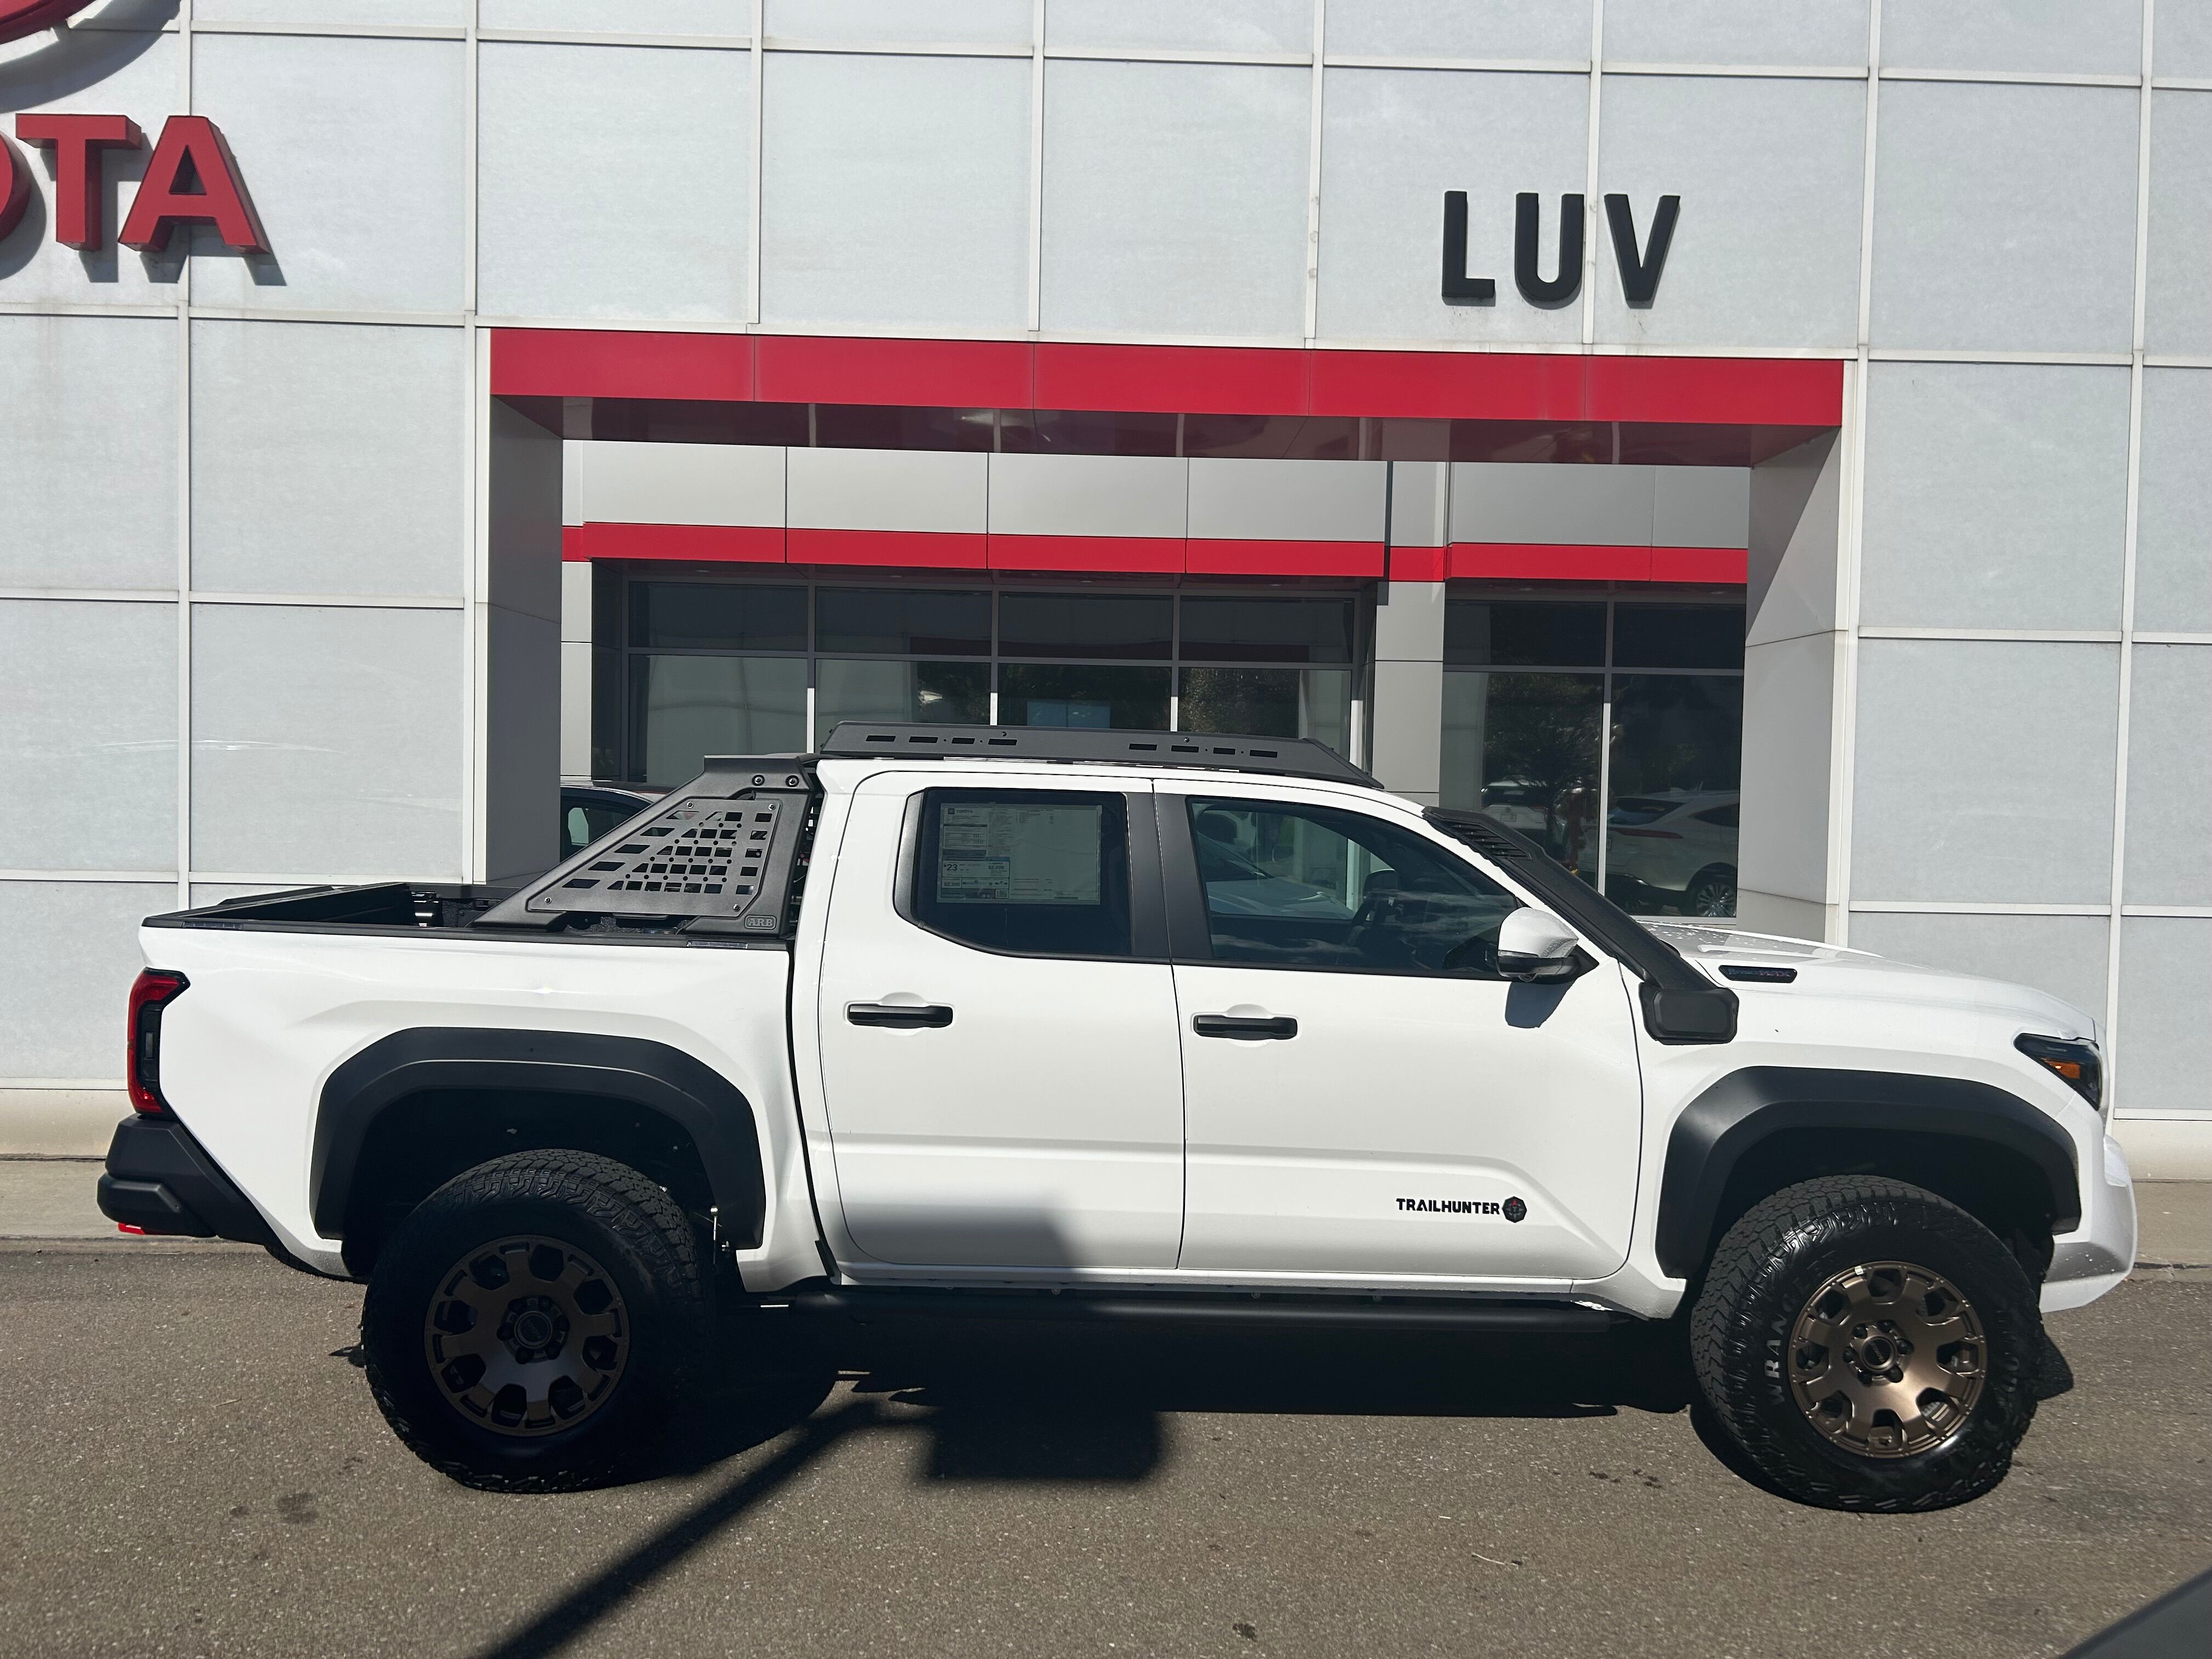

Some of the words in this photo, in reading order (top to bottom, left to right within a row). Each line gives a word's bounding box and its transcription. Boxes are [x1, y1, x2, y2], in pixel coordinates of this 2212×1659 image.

[0, 113, 270, 255] TA
[1441, 190, 1681, 307] LUV
[747, 918, 773, 927] ARB
[1396, 1198, 1500, 1215] TRAILHUNTER
